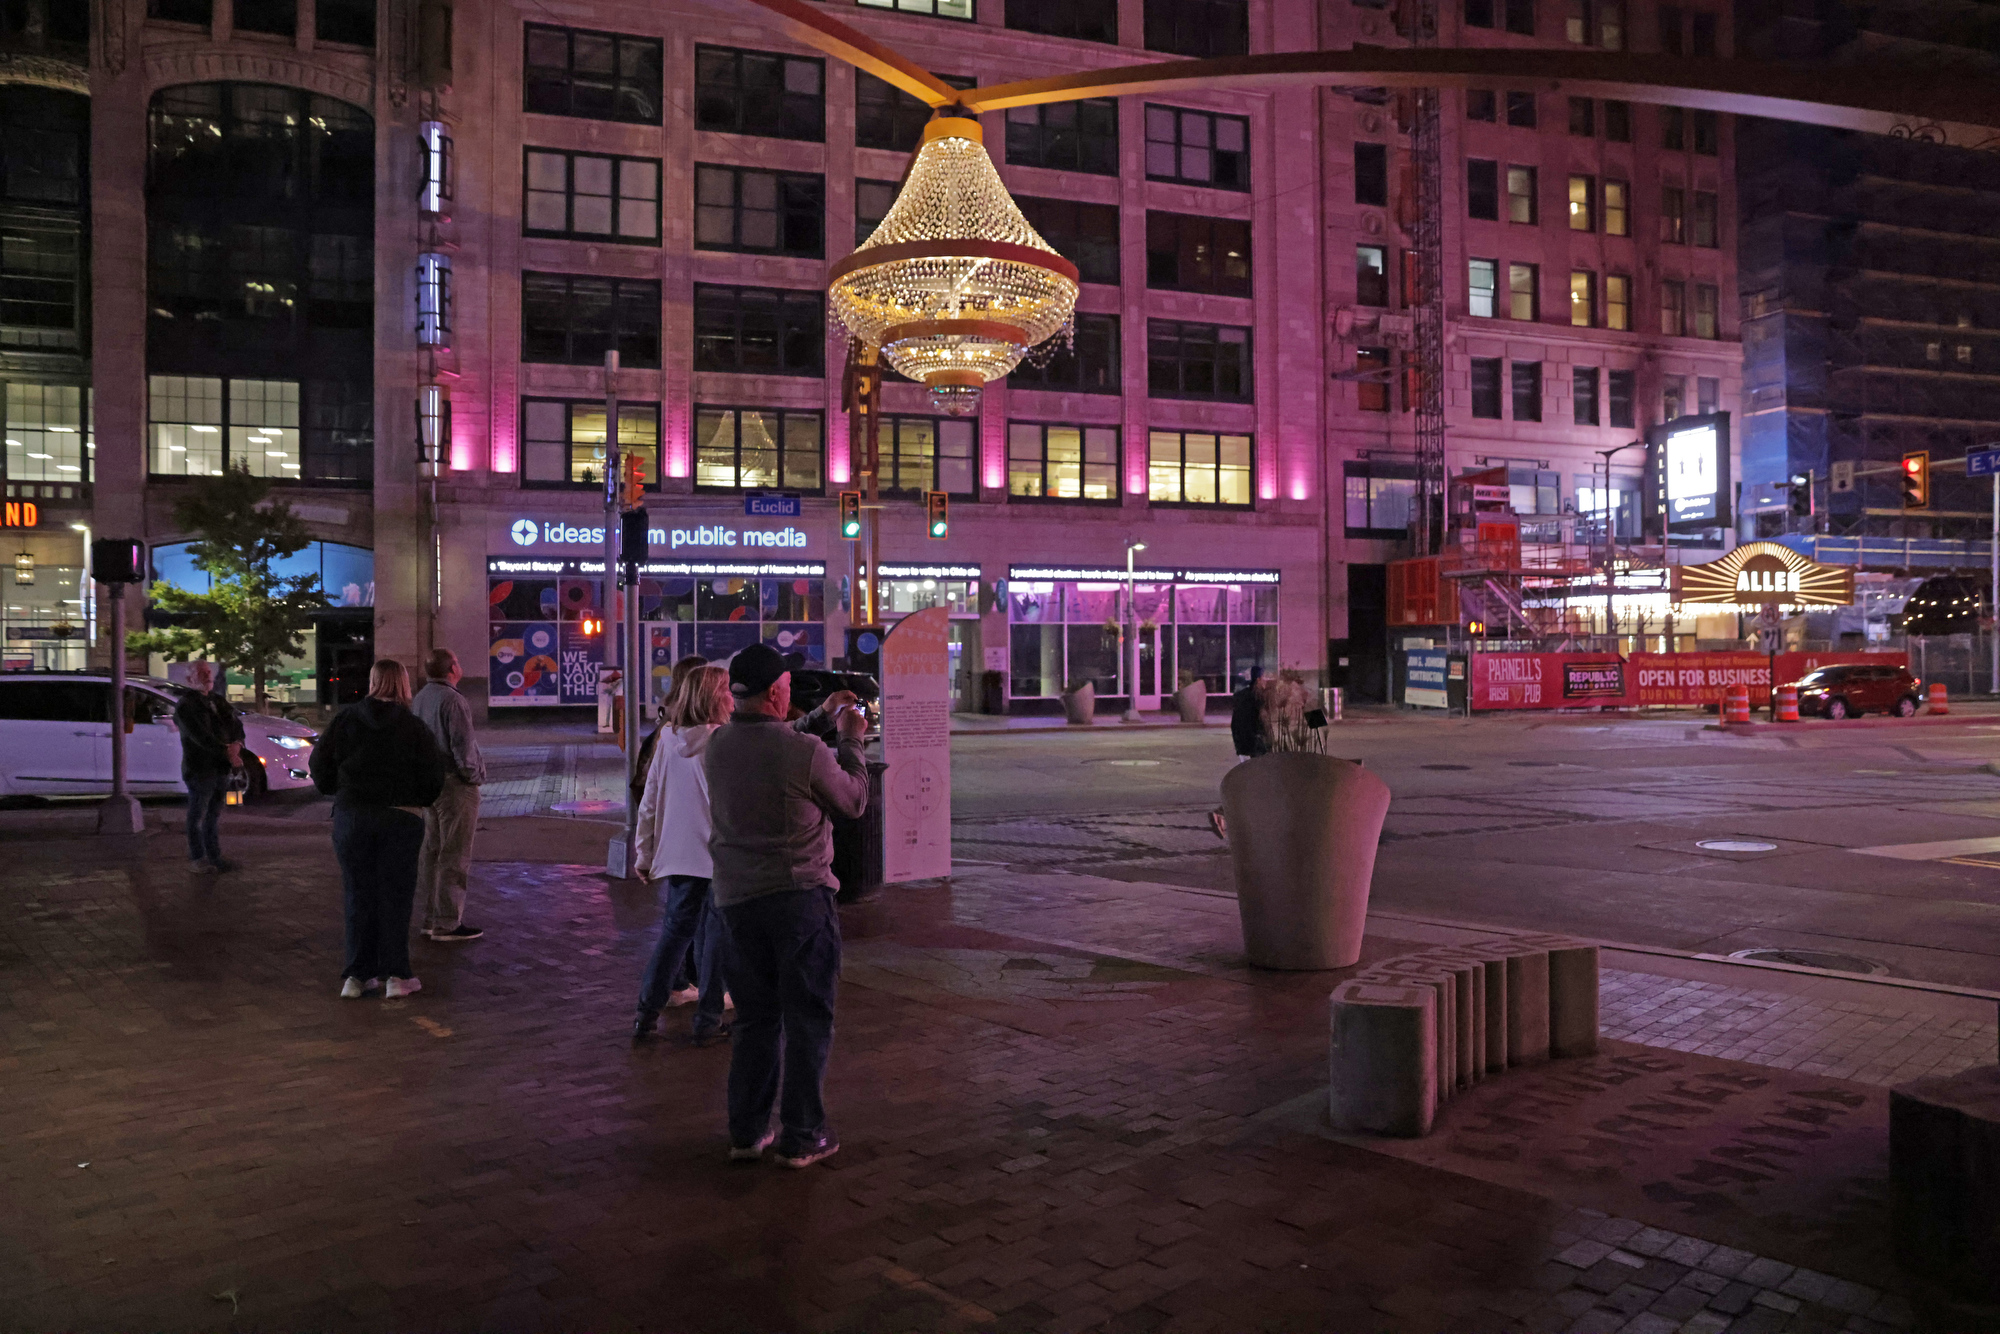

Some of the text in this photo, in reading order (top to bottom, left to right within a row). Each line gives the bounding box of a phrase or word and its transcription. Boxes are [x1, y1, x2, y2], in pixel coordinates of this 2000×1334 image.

[1658, 444, 1666, 514] ALLEN
[751, 500, 794, 514] Euclid
[671, 526, 737, 549] public
[743, 528, 807, 548] media
[648, 564, 691, 574] community
[911, 567, 919, 575] to
[920, 567, 941, 577] voting
[942, 567, 949, 576] in
[950, 567, 967, 576] Ohio
[1736, 570, 1800, 592] ALLEN
[563, 651, 588, 663] WE
[1489, 658, 1542, 681] PARNELL'S
[1569, 671, 1619, 682] REPUBLIC
[1639, 670, 1675, 687] OPEN
[1679, 669, 1705, 687] FOR
[1489, 684, 1541, 703] IRISH PUB
[1640, 689, 1683, 701] DURING
